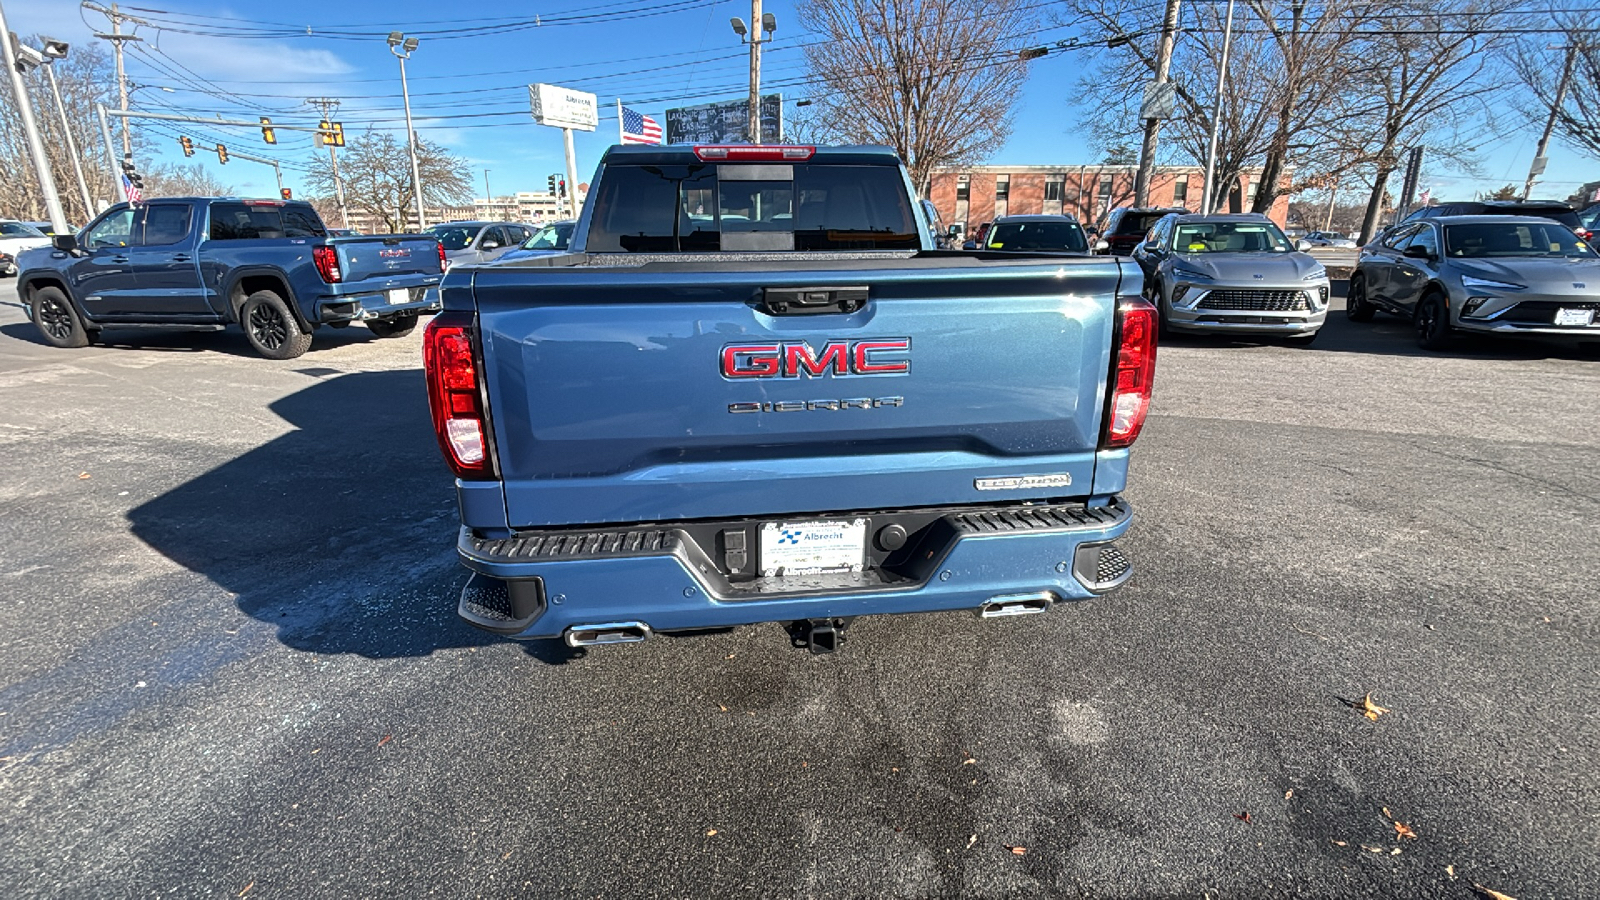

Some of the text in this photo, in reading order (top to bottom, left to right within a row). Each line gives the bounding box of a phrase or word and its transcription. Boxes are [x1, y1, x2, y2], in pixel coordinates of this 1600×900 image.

[719, 336, 912, 381] GMC
[728, 396, 904, 413] SIERRA
[804, 532, 843, 541] Albrecht
